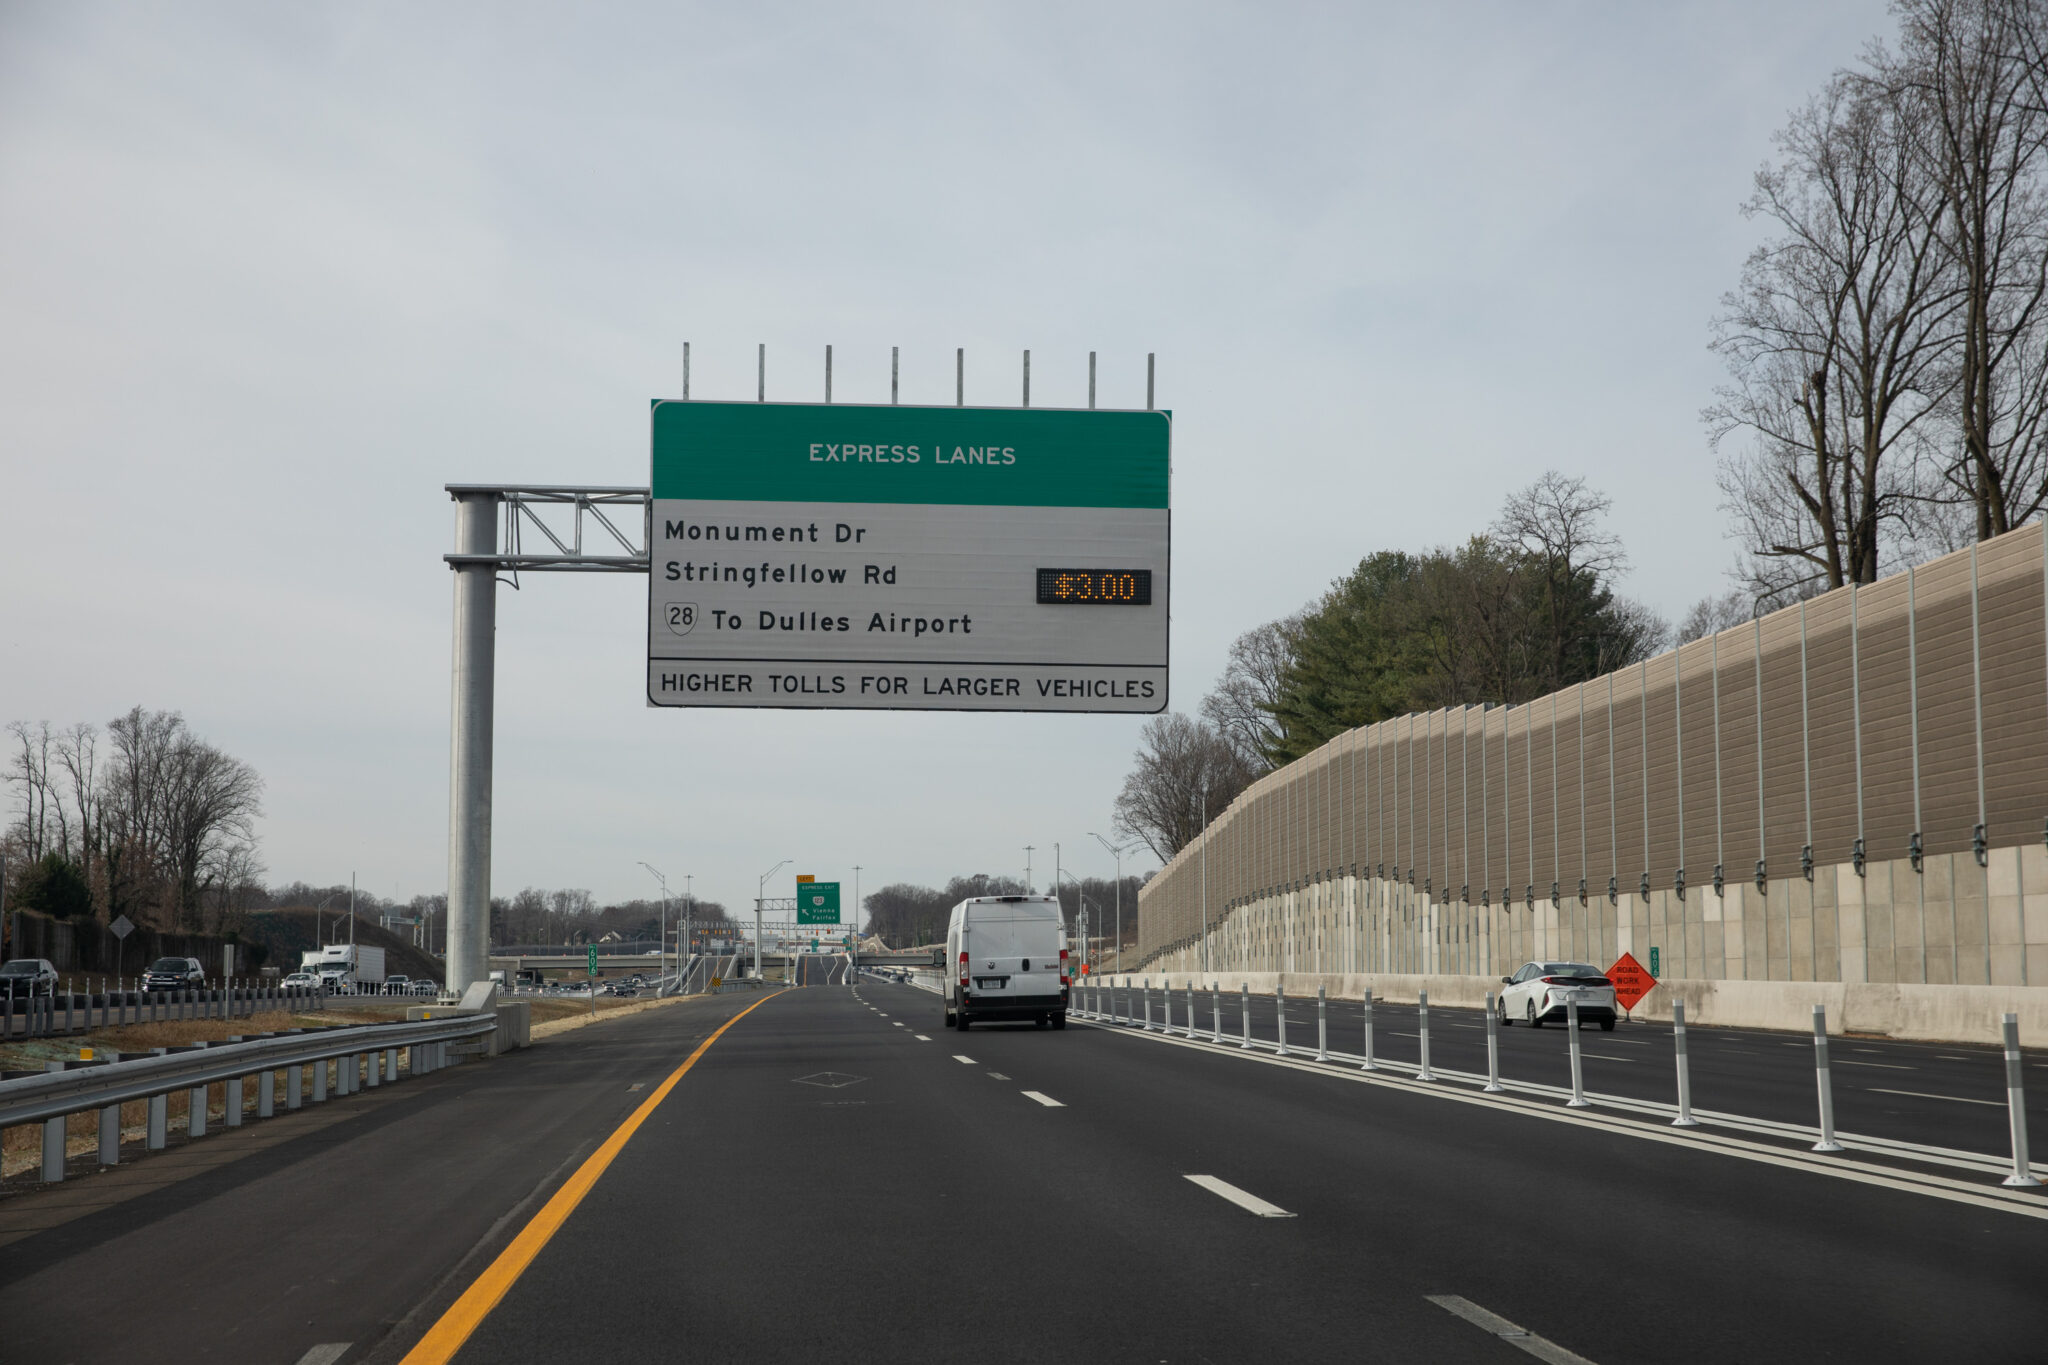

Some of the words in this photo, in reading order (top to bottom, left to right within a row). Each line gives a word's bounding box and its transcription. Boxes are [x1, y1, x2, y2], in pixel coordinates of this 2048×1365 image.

[808, 443, 922, 464] EXPRESS
[934, 446, 1017, 466] LANES
[664, 520, 819, 544] Monument
[834, 523, 867, 544] Dr
[664, 560, 848, 589] Stringfellow
[863, 564, 897, 586] Rd
[1055, 573, 1134, 600] $3.00
[669, 606, 694, 627] 28
[711, 609, 743, 631] To
[758, 610, 851, 633] Dulles
[867, 613, 973, 638] Airport
[660, 672, 754, 694] HIGHER
[768, 674, 847, 695] TOLLS
[860, 675, 909, 696] FOR
[922, 676, 1022, 698] LARGER
[1036, 678, 1156, 700] VEHICLES
[1616, 987, 1641, 995] AHEAD
